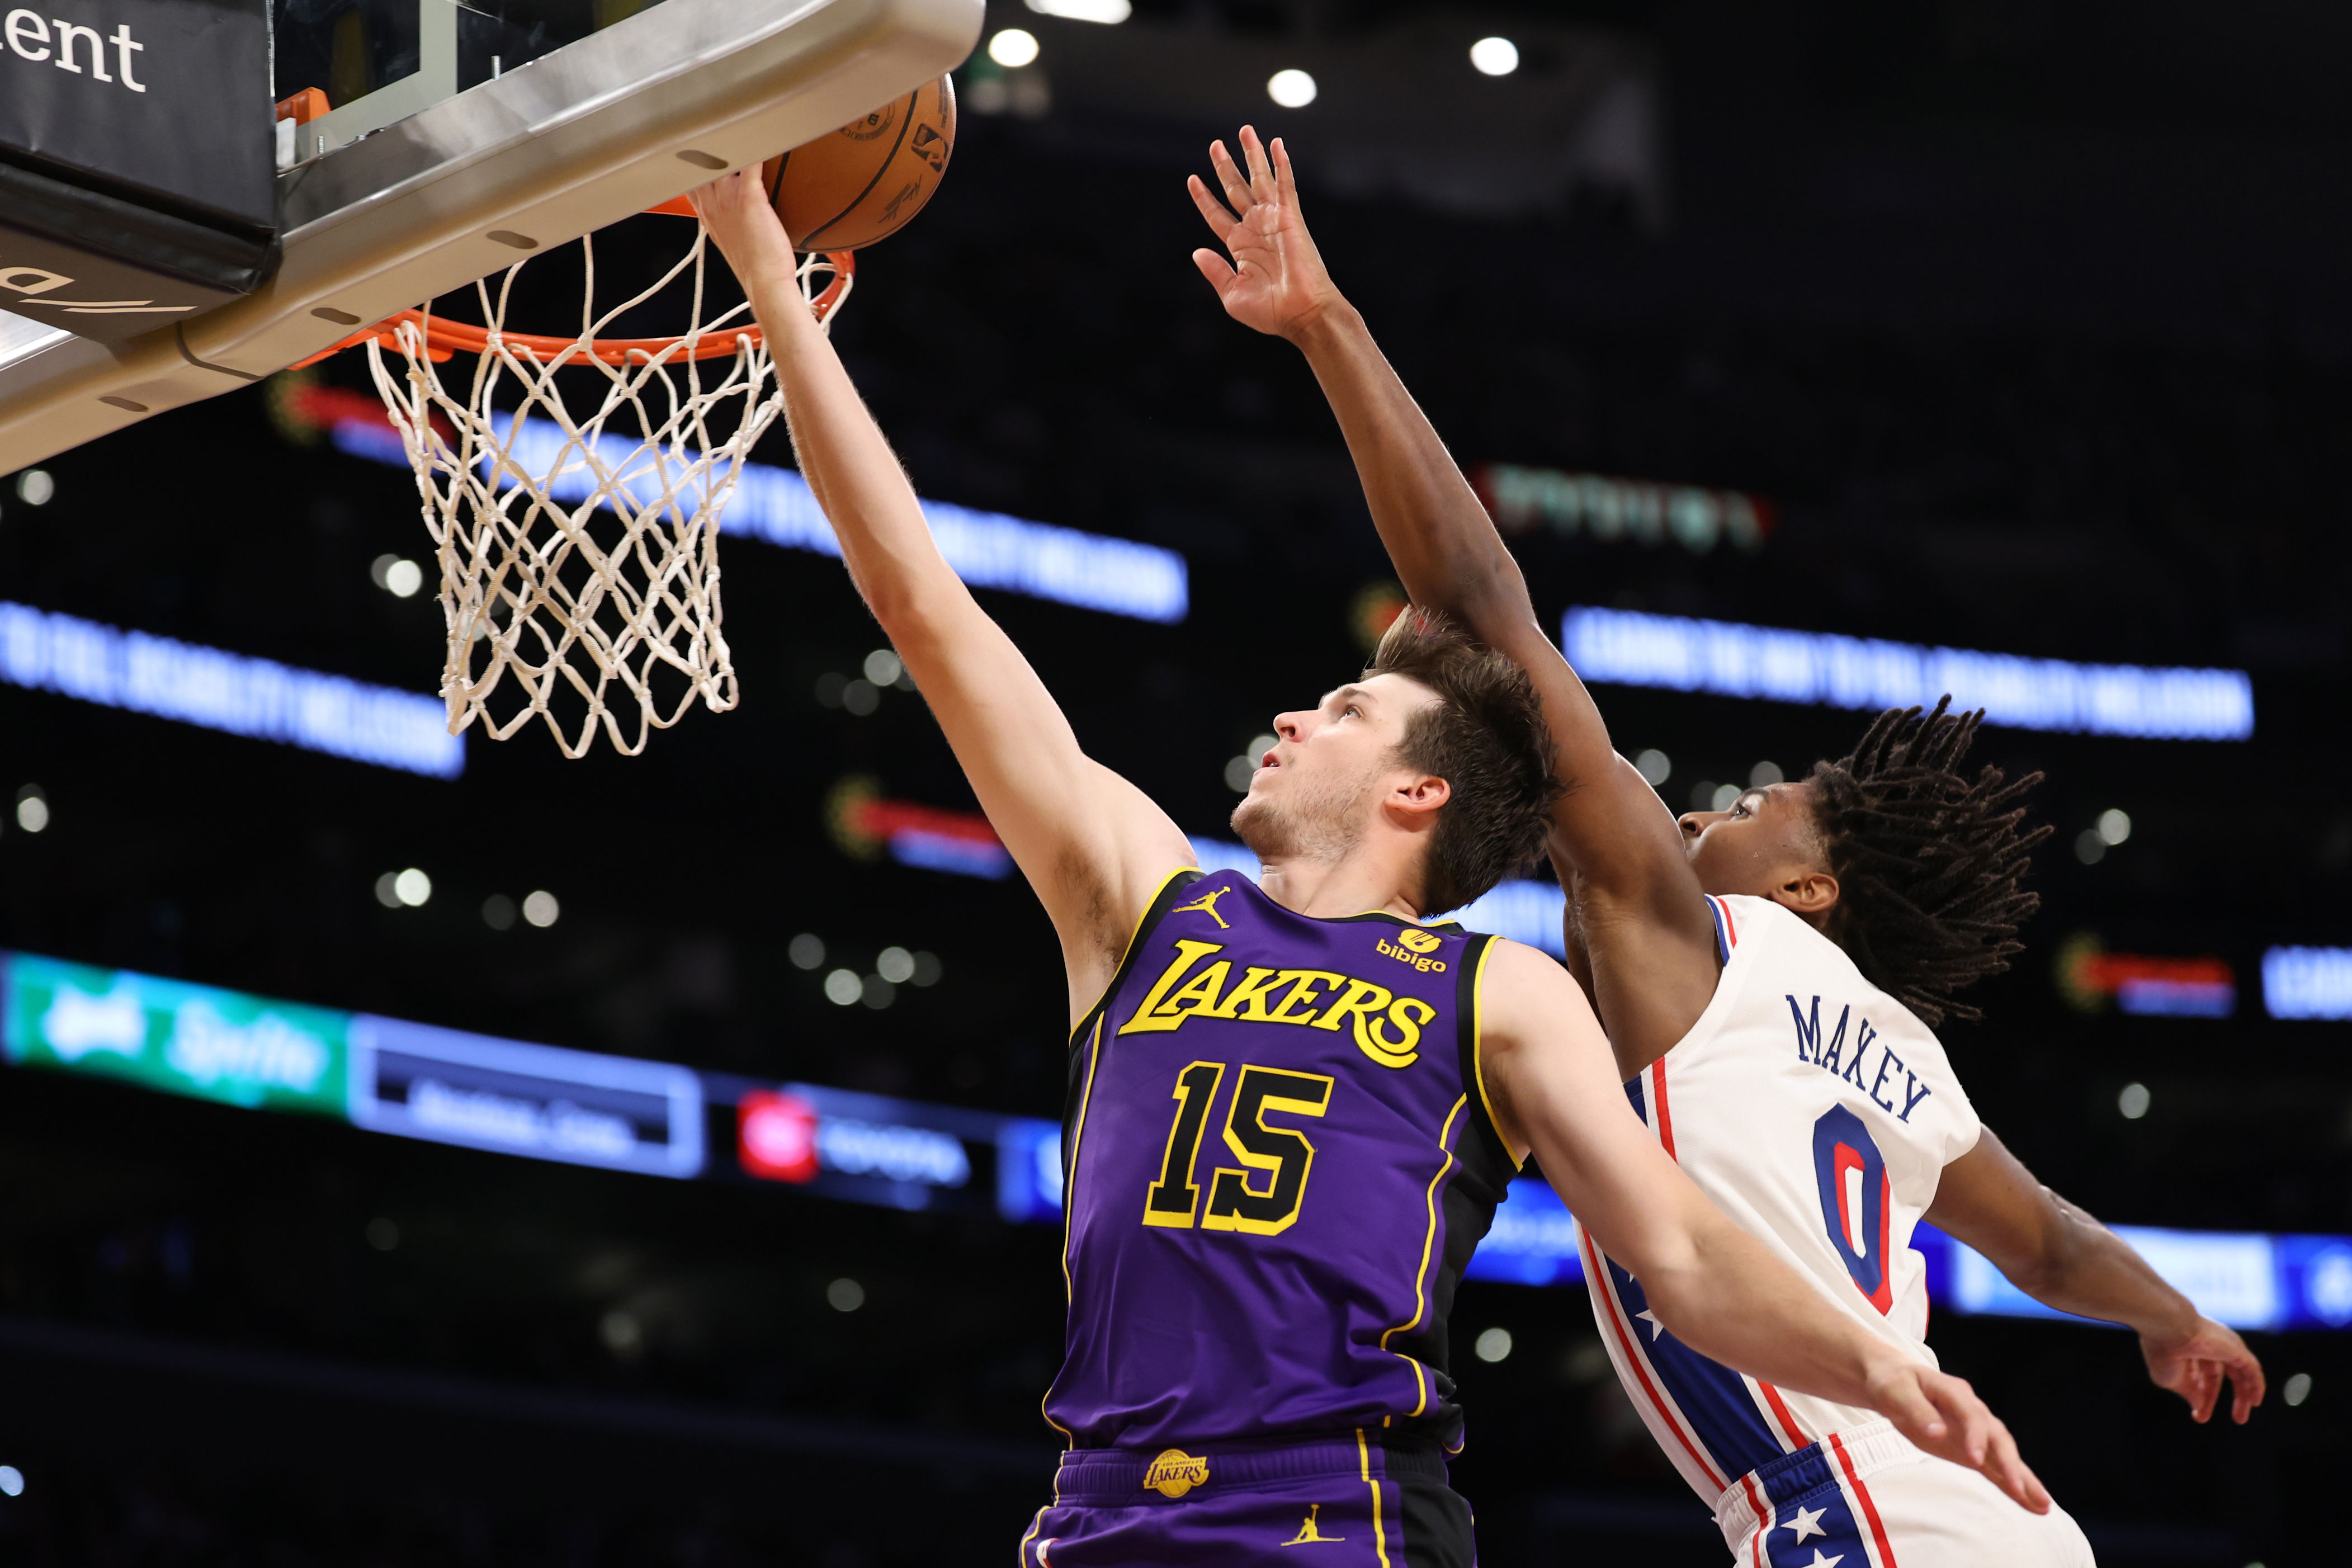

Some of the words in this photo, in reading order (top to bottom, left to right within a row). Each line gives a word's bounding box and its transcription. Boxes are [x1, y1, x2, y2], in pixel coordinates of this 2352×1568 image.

[0, 8, 146, 93] ent
[1116, 938, 1438, 1069] LAKERS
[1376, 938, 1447, 972] bibigo
[1786, 994, 1931, 1123] MAXEY
[1142, 1060, 1335, 1236] 15
[1812, 1102, 1893, 1317] 0
[1148, 1463, 1203, 1486] LAKERS
